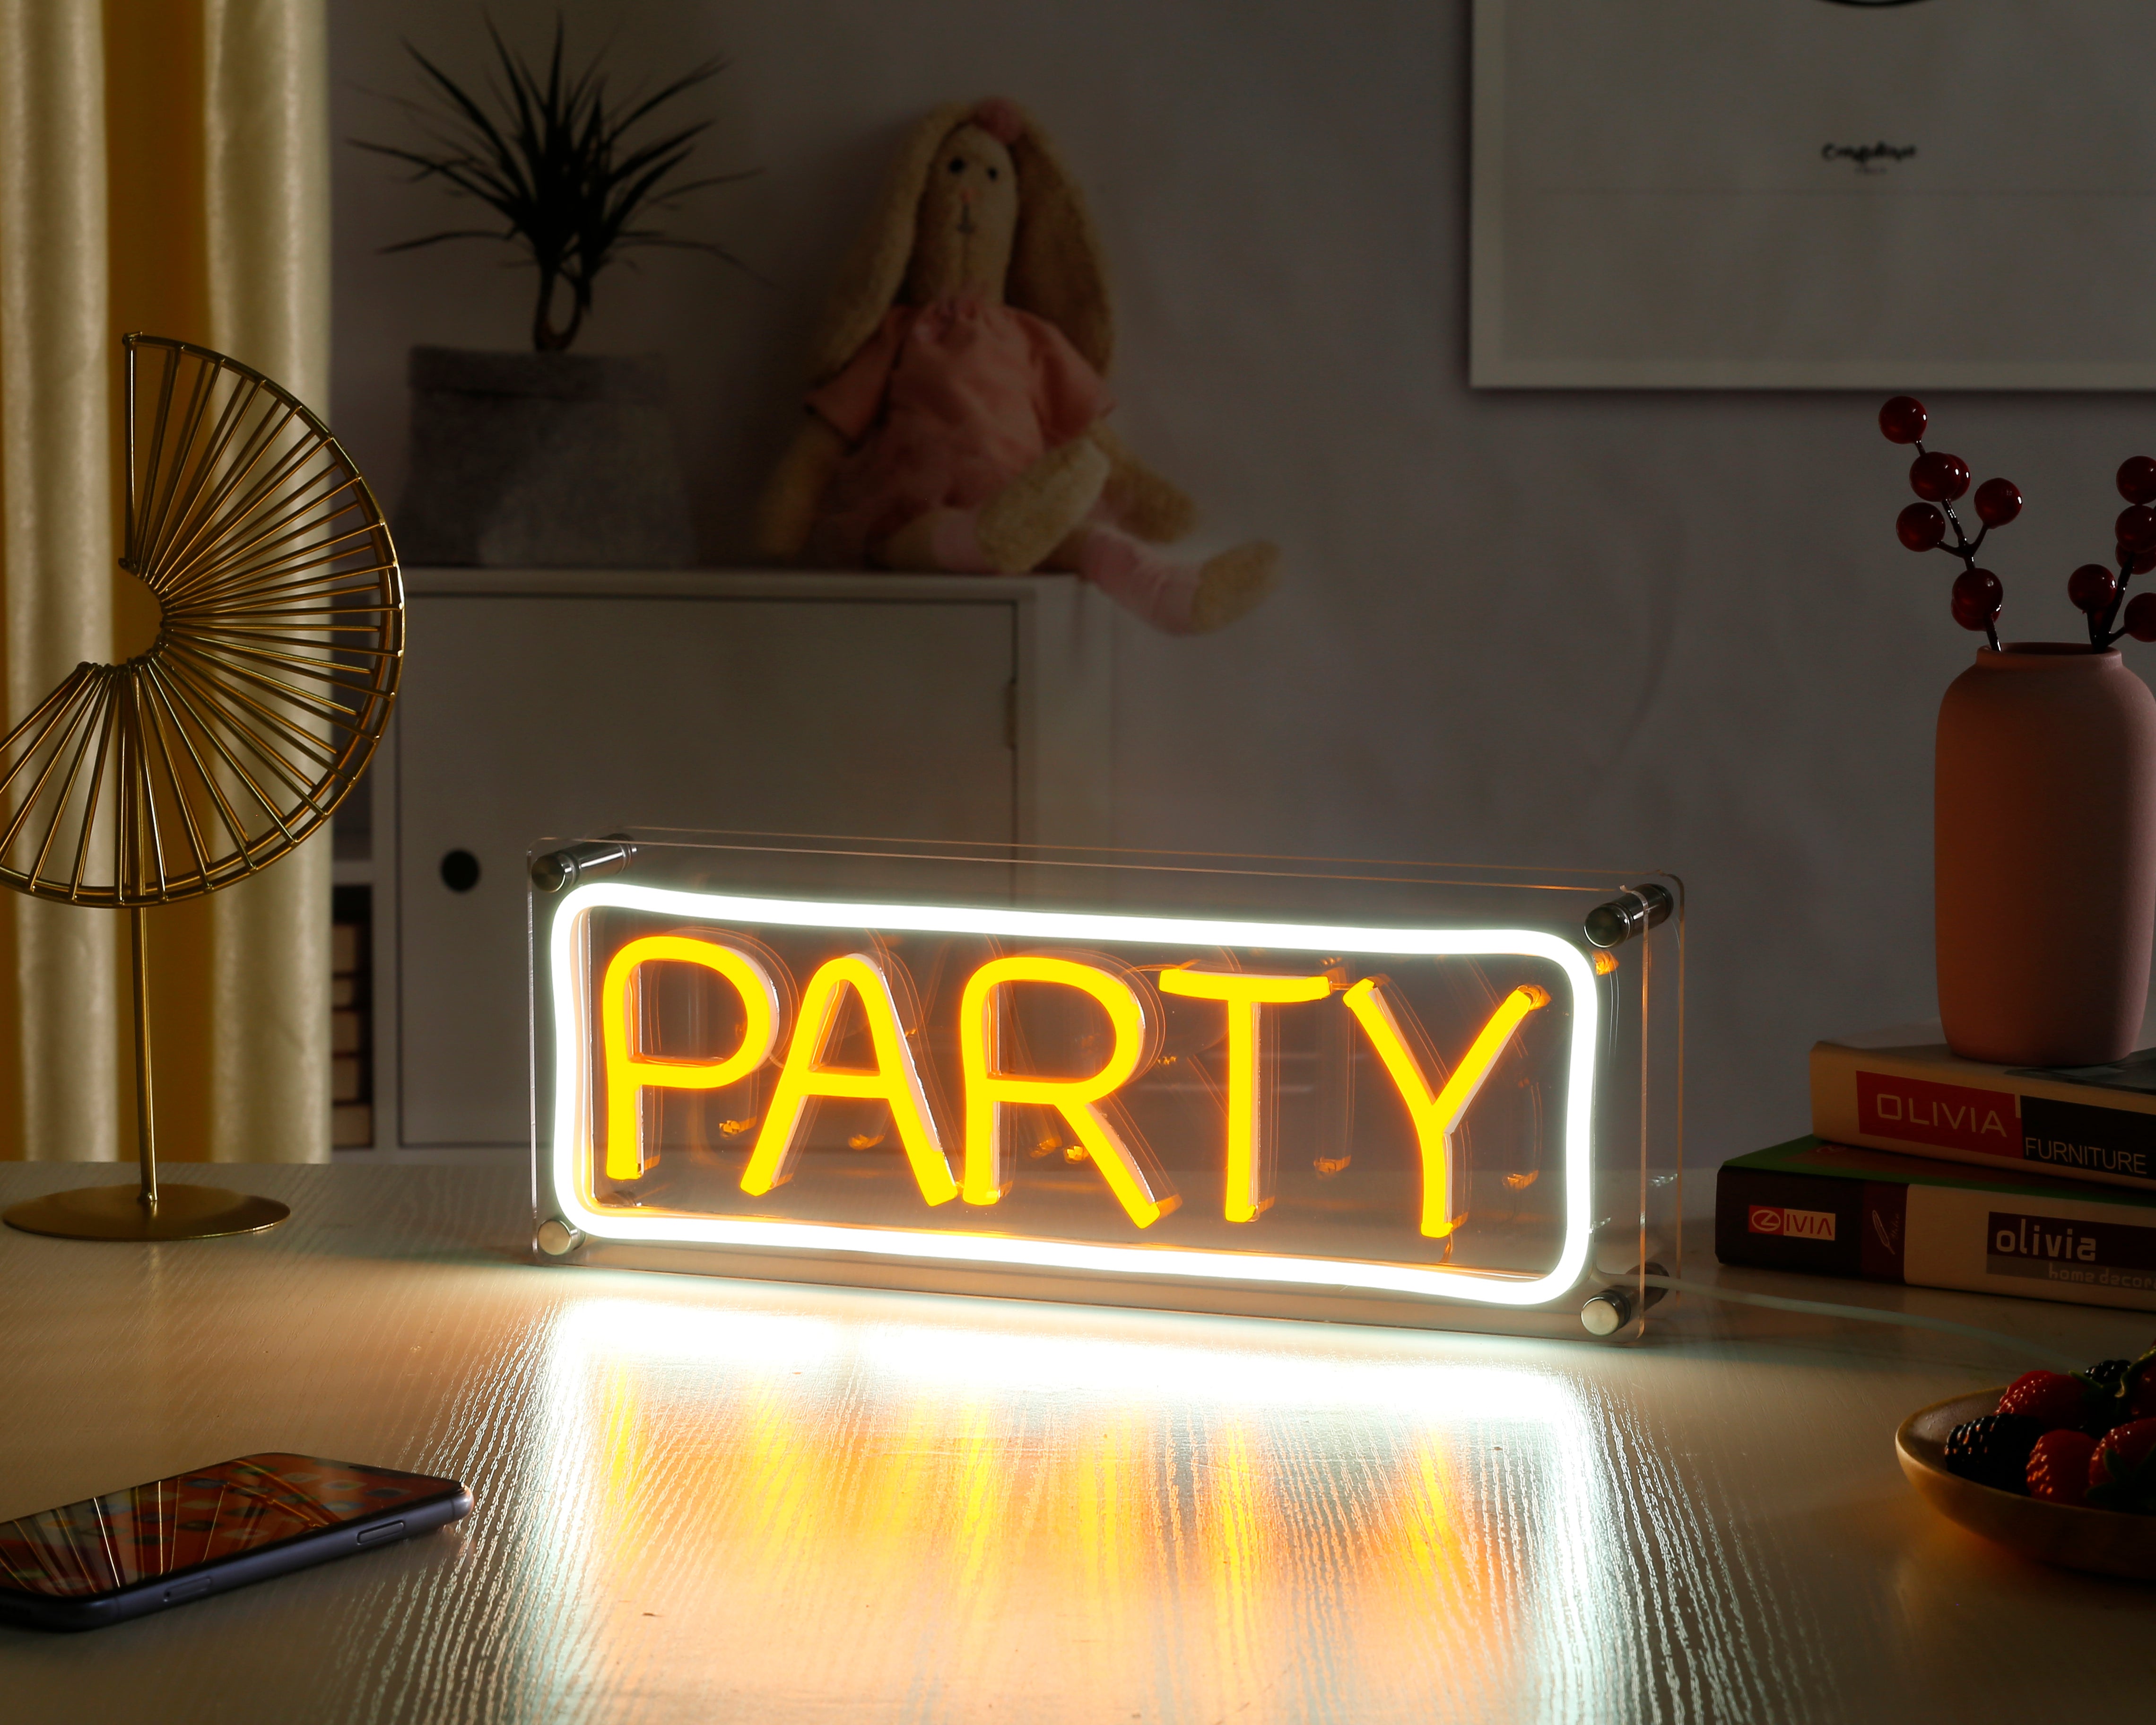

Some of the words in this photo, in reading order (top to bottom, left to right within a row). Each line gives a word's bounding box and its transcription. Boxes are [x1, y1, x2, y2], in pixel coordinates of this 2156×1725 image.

[602, 935, 1547, 1238] PARTY
[1877, 1093, 2007, 1138] OLIVIA
[2025, 1137, 2148, 1175] FURNITURE
[1996, 1218, 2096, 1262] olivia
[2049, 1262, 2095, 1282] home
